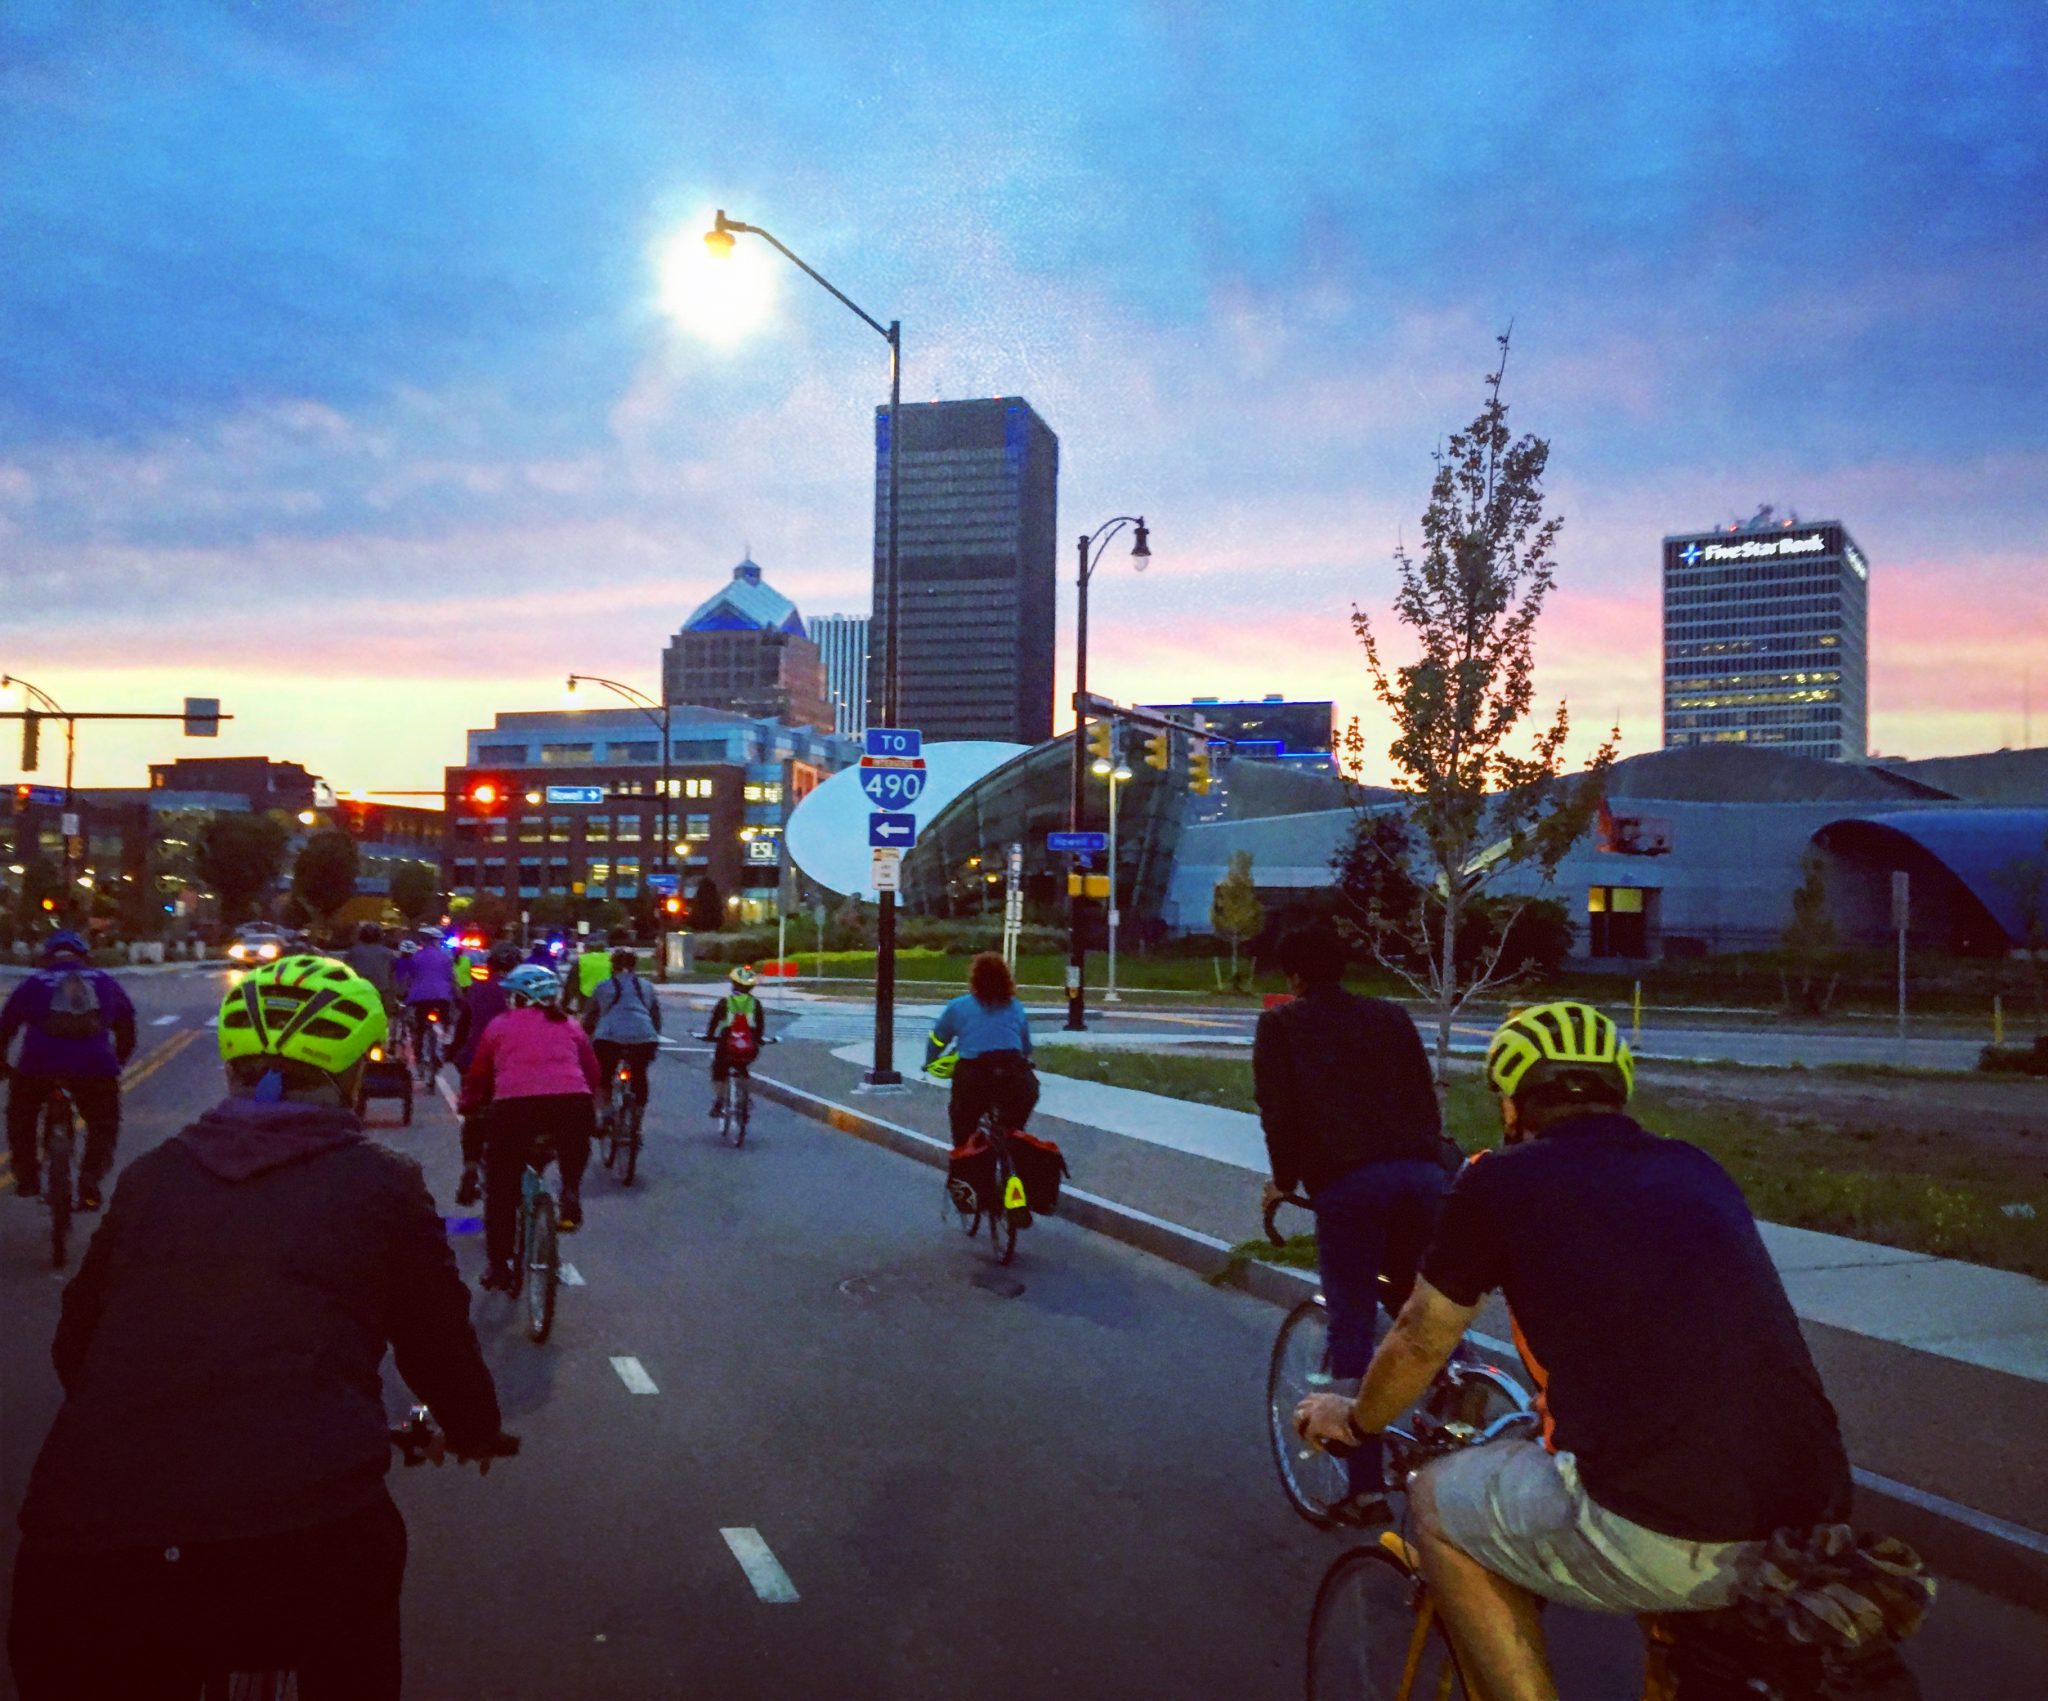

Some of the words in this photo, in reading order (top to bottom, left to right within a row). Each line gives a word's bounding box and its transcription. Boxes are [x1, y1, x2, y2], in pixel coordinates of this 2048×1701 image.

[1780, 534, 1825, 554] Bank
[882, 735, 906, 751] TO
[865, 773, 920, 800] 490
[751, 842, 777, 858] ESL
